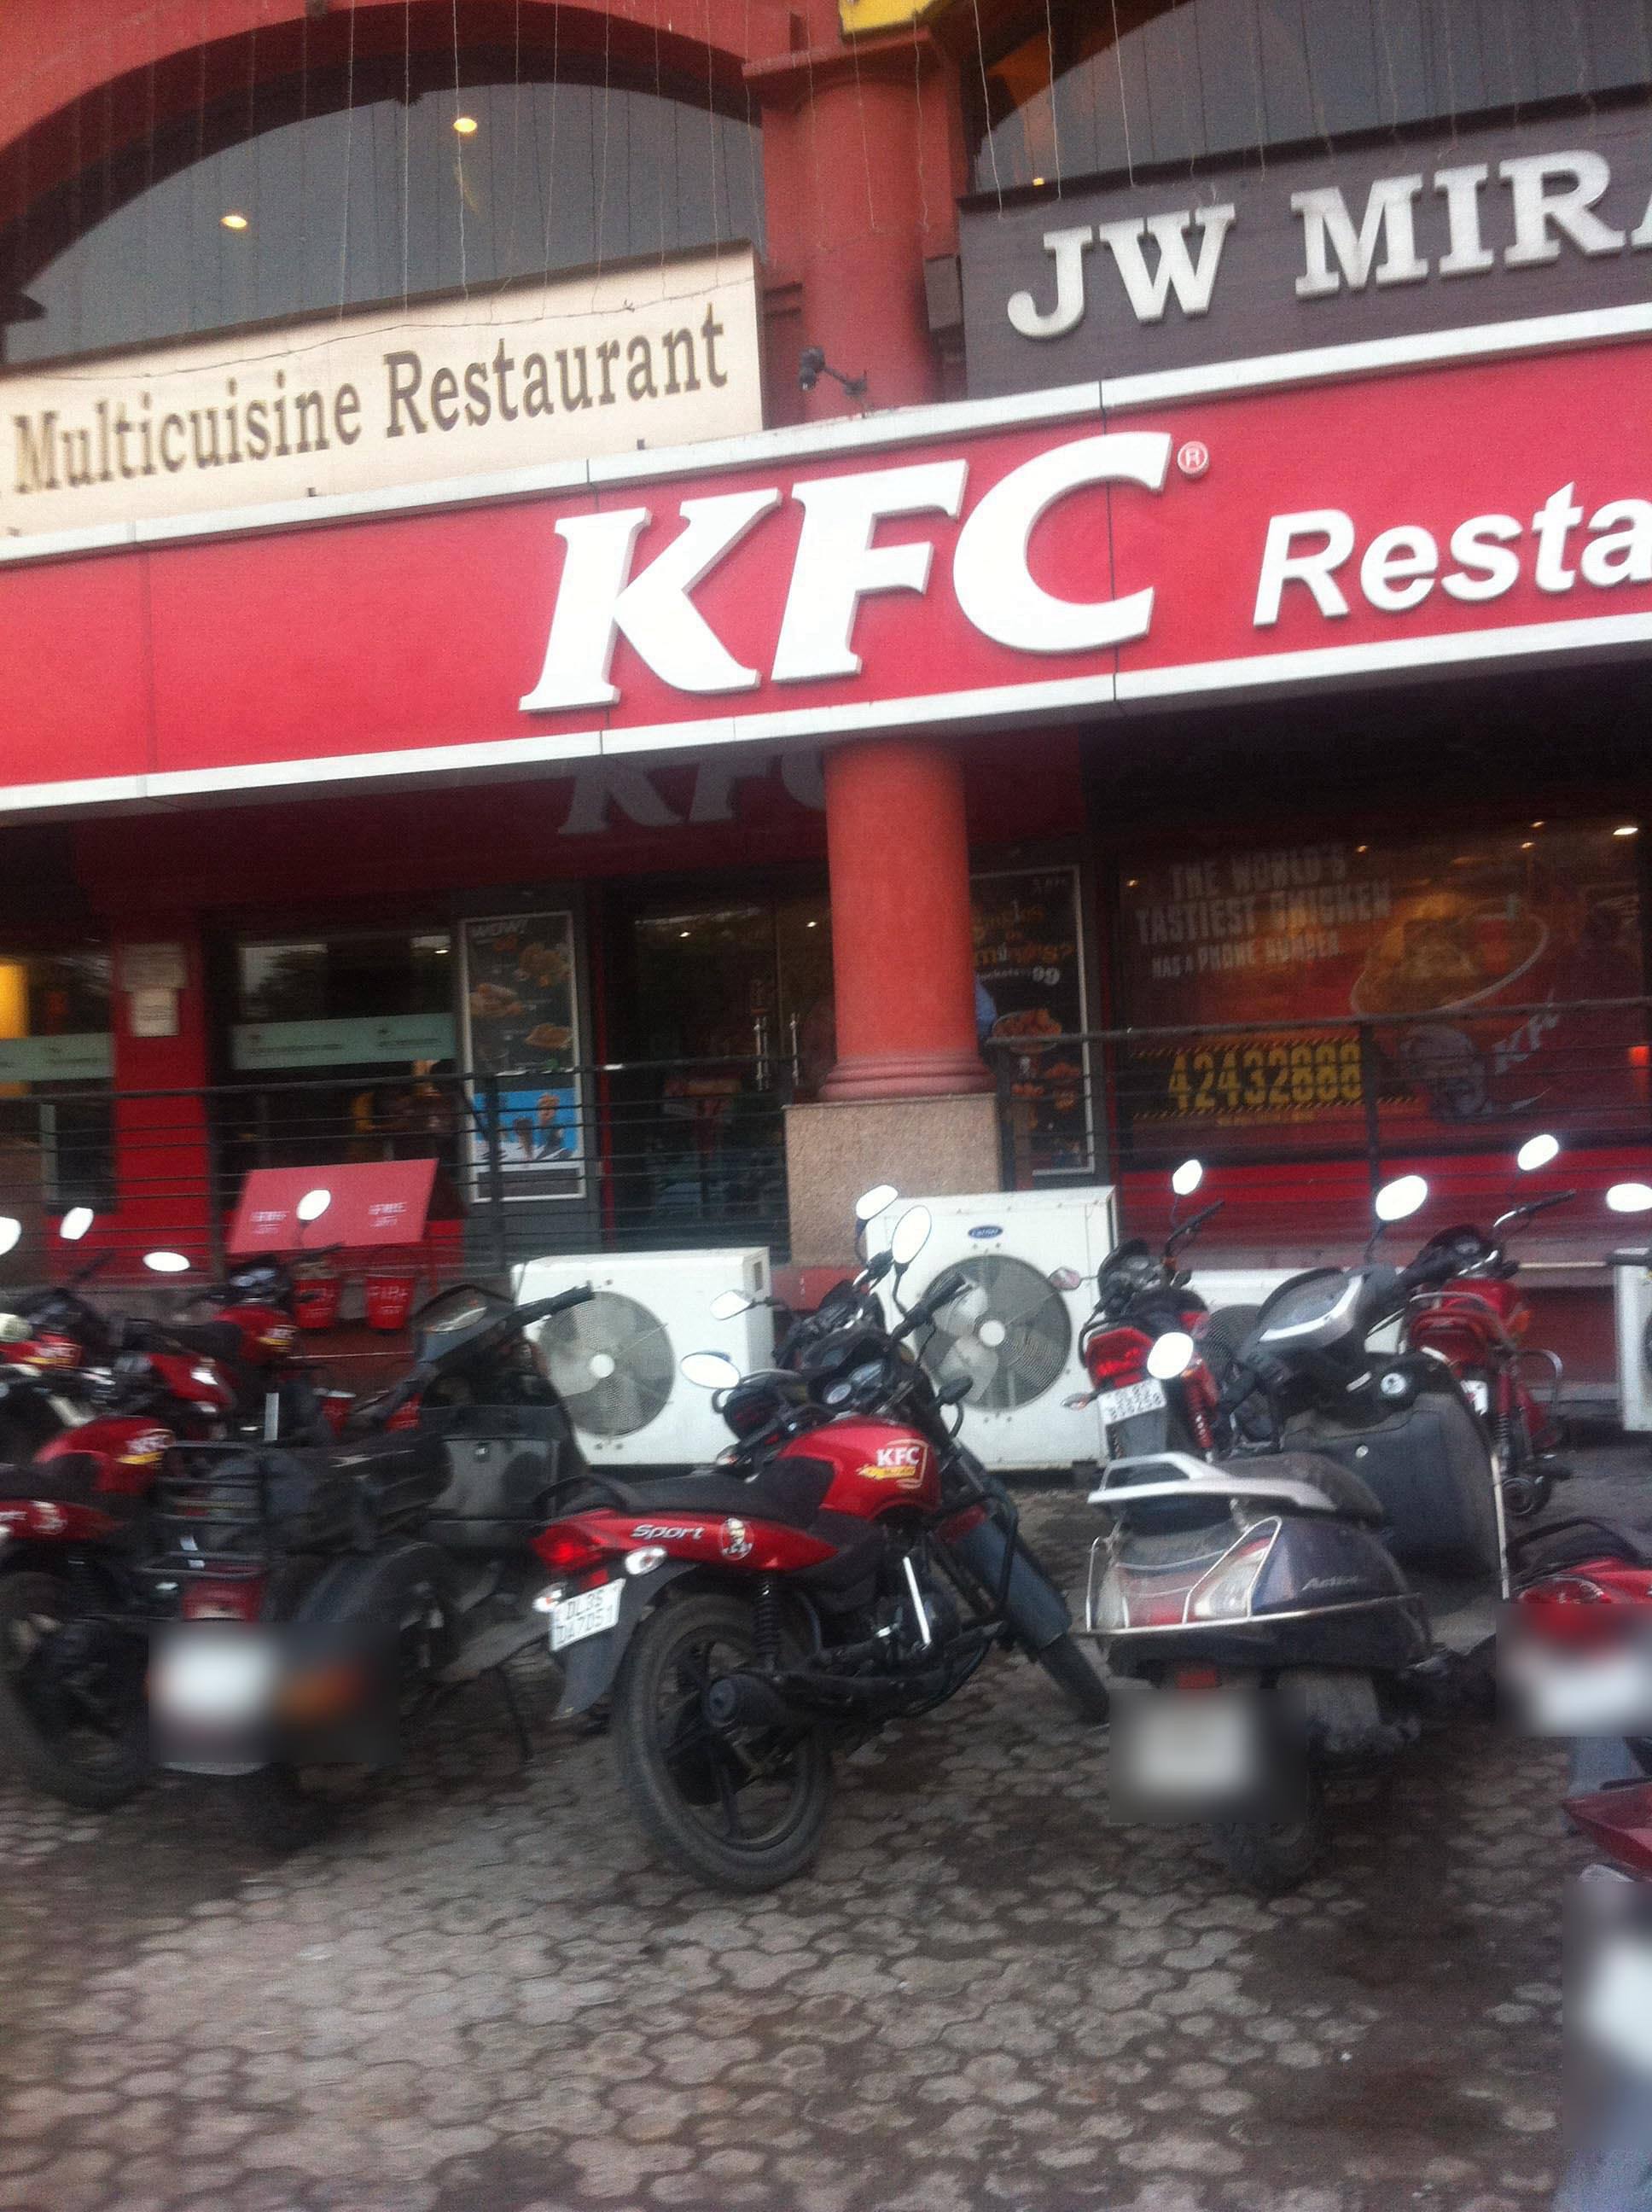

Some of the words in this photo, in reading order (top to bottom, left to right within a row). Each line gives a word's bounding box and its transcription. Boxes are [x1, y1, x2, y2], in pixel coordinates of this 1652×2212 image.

[1008, 203, 1236, 339] JW
[1290, 149, 1652, 300] MIR
[13, 370, 363, 495] Multicuisine
[384, 301, 729, 439] Restaurant
[519, 432, 1174, 713] KFC
[1253, 481, 1652, 630] Resta
[1170, 860, 1219, 902] THE
[1230, 844, 1347, 894] WORLD'S
[1136, 896, 1256, 946] TASTIEST
[1269, 879, 1391, 932] CHICKEN
[1152, 955, 1181, 979] HAS
[1197, 940, 1257, 973] PHONE
[876, 1446, 921, 1468] KFC
[631, 1523, 706, 1540] Sport
